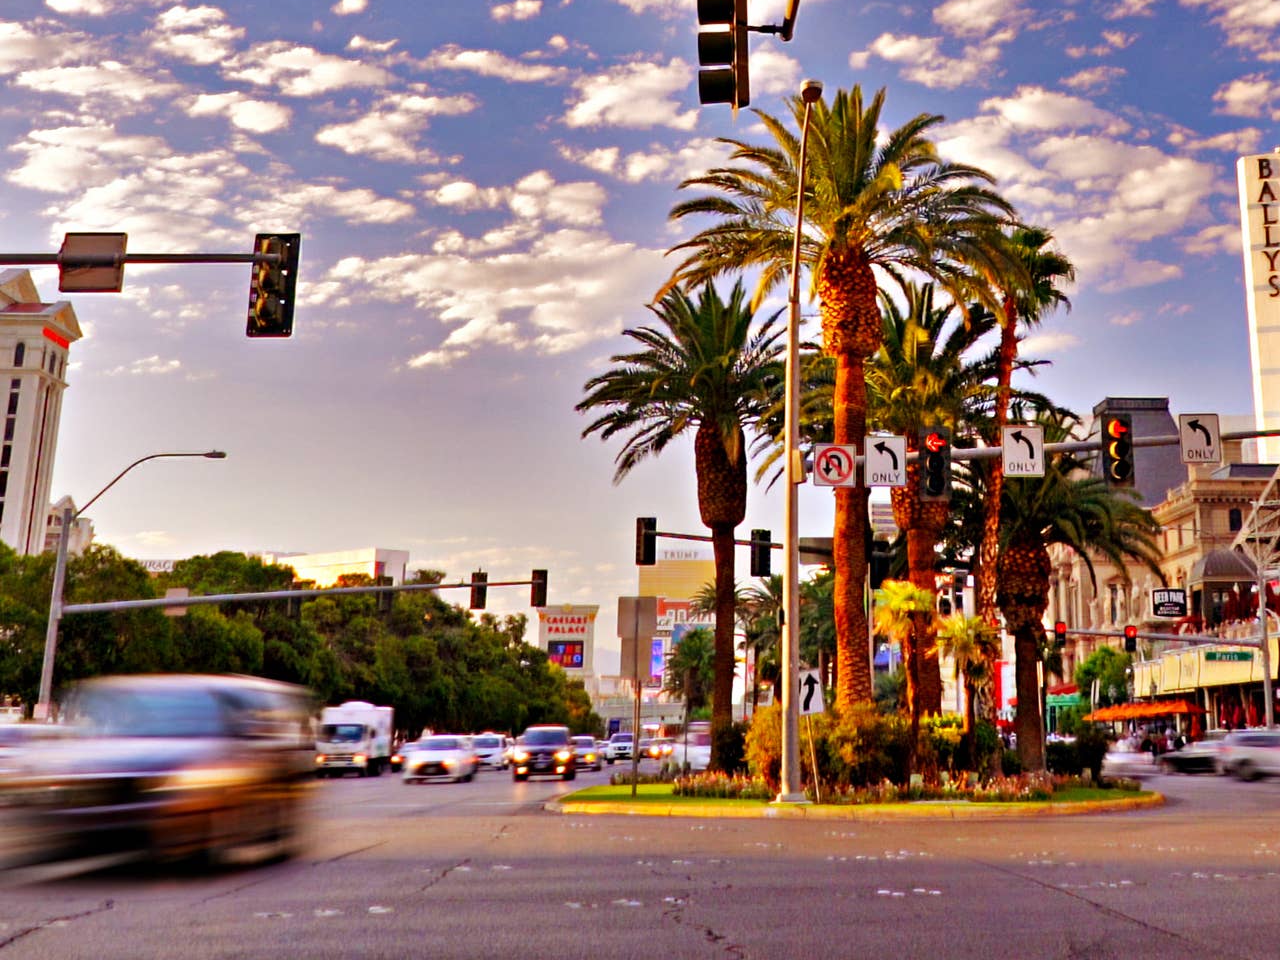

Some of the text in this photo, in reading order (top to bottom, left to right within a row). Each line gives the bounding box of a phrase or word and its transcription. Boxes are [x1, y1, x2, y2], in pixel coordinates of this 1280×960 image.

[1257, 158, 1280, 297] BALLYS
[1188, 449, 1214, 459] ONLY
[1008, 462, 1036, 472] ONLY
[872, 472, 900, 483] ONLY
[664, 551, 699, 559] TRUMP
[1216, 651, 1239, 661] Paris
